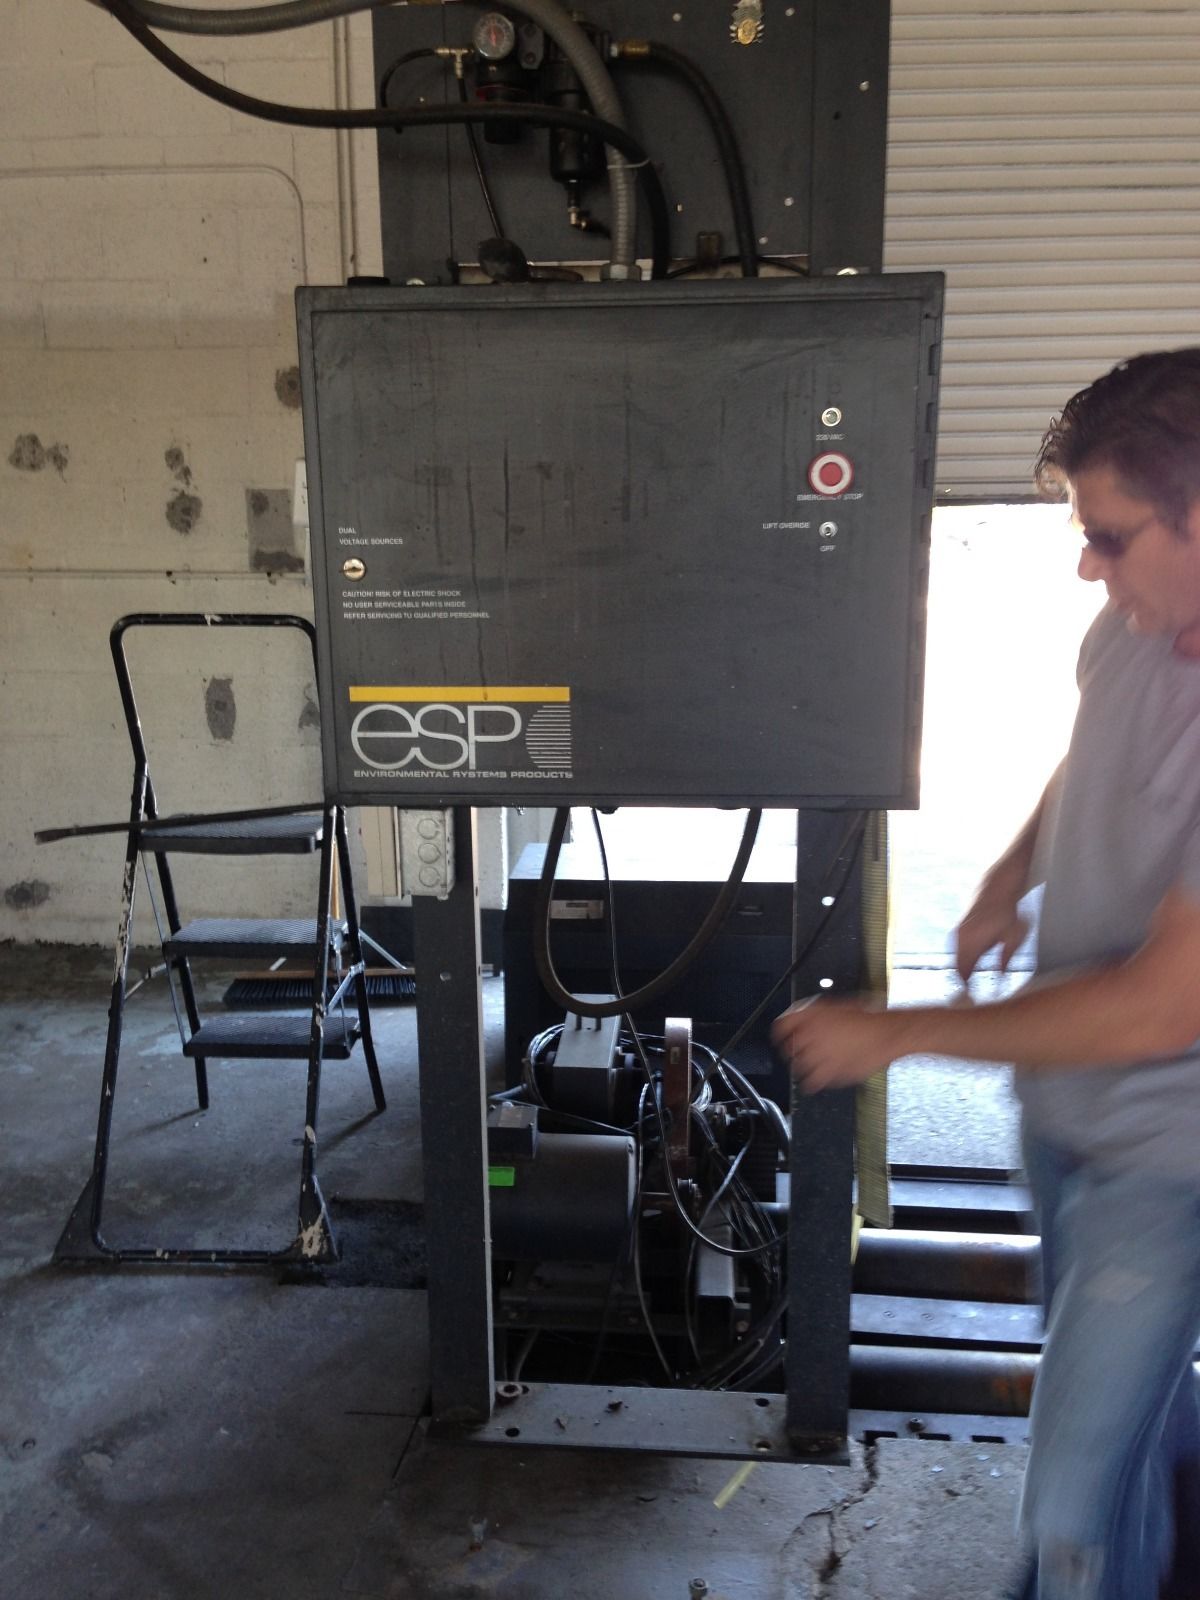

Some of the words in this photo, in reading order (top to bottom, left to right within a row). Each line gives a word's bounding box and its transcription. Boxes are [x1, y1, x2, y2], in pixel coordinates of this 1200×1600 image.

[353, 770, 450, 778] ENVIRONMENTAL
[452, 770, 507, 779] SYSTEMS
[510, 770, 573, 779] PRODUCTS
